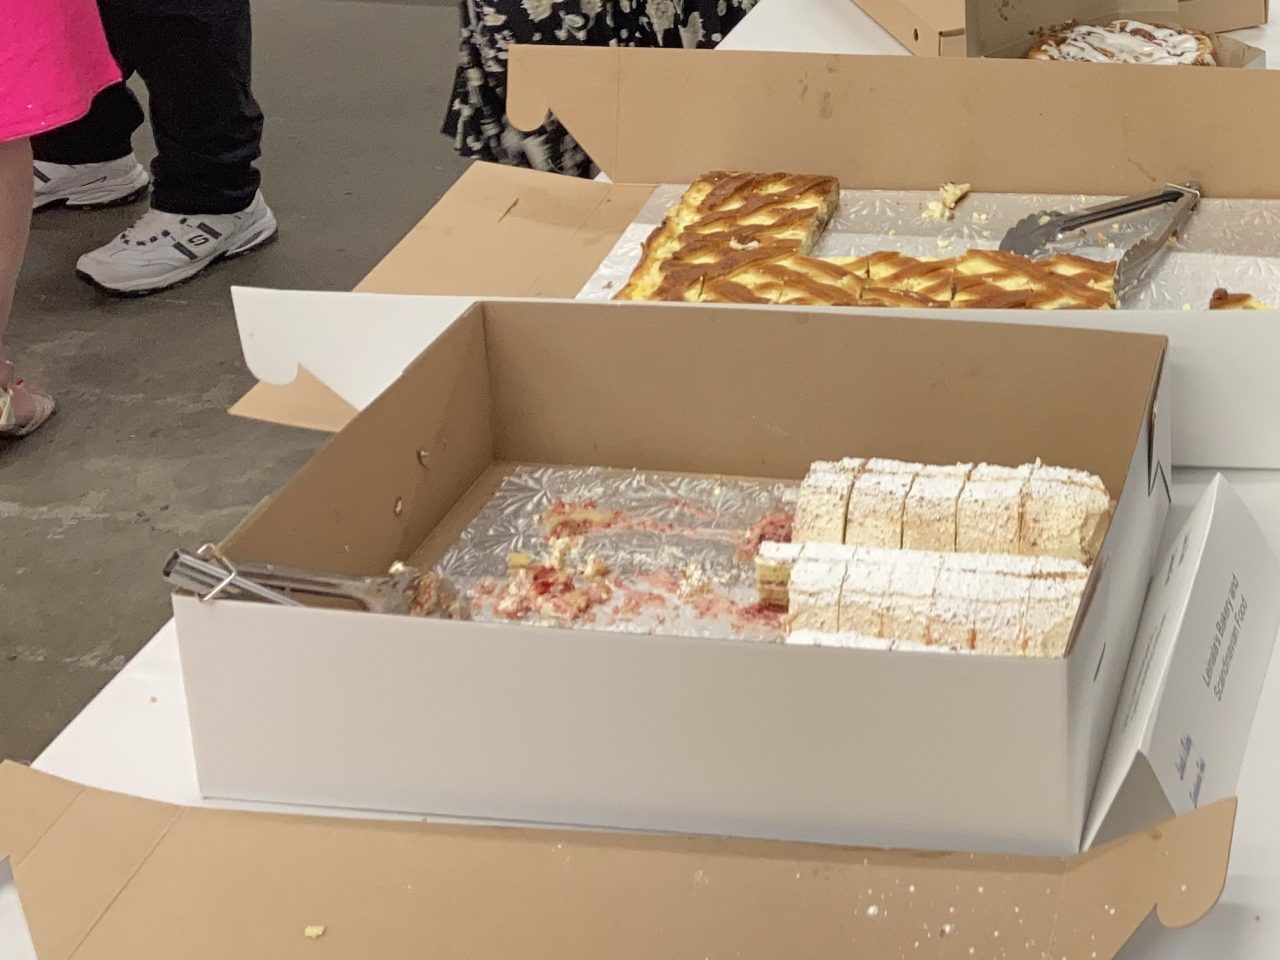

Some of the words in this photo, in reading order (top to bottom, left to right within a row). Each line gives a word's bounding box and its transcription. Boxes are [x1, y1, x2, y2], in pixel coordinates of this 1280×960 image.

[1215, 597, 1235, 639] Bakery
[1229, 571, 1239, 600] and
[1234, 593, 1248, 629] Food
